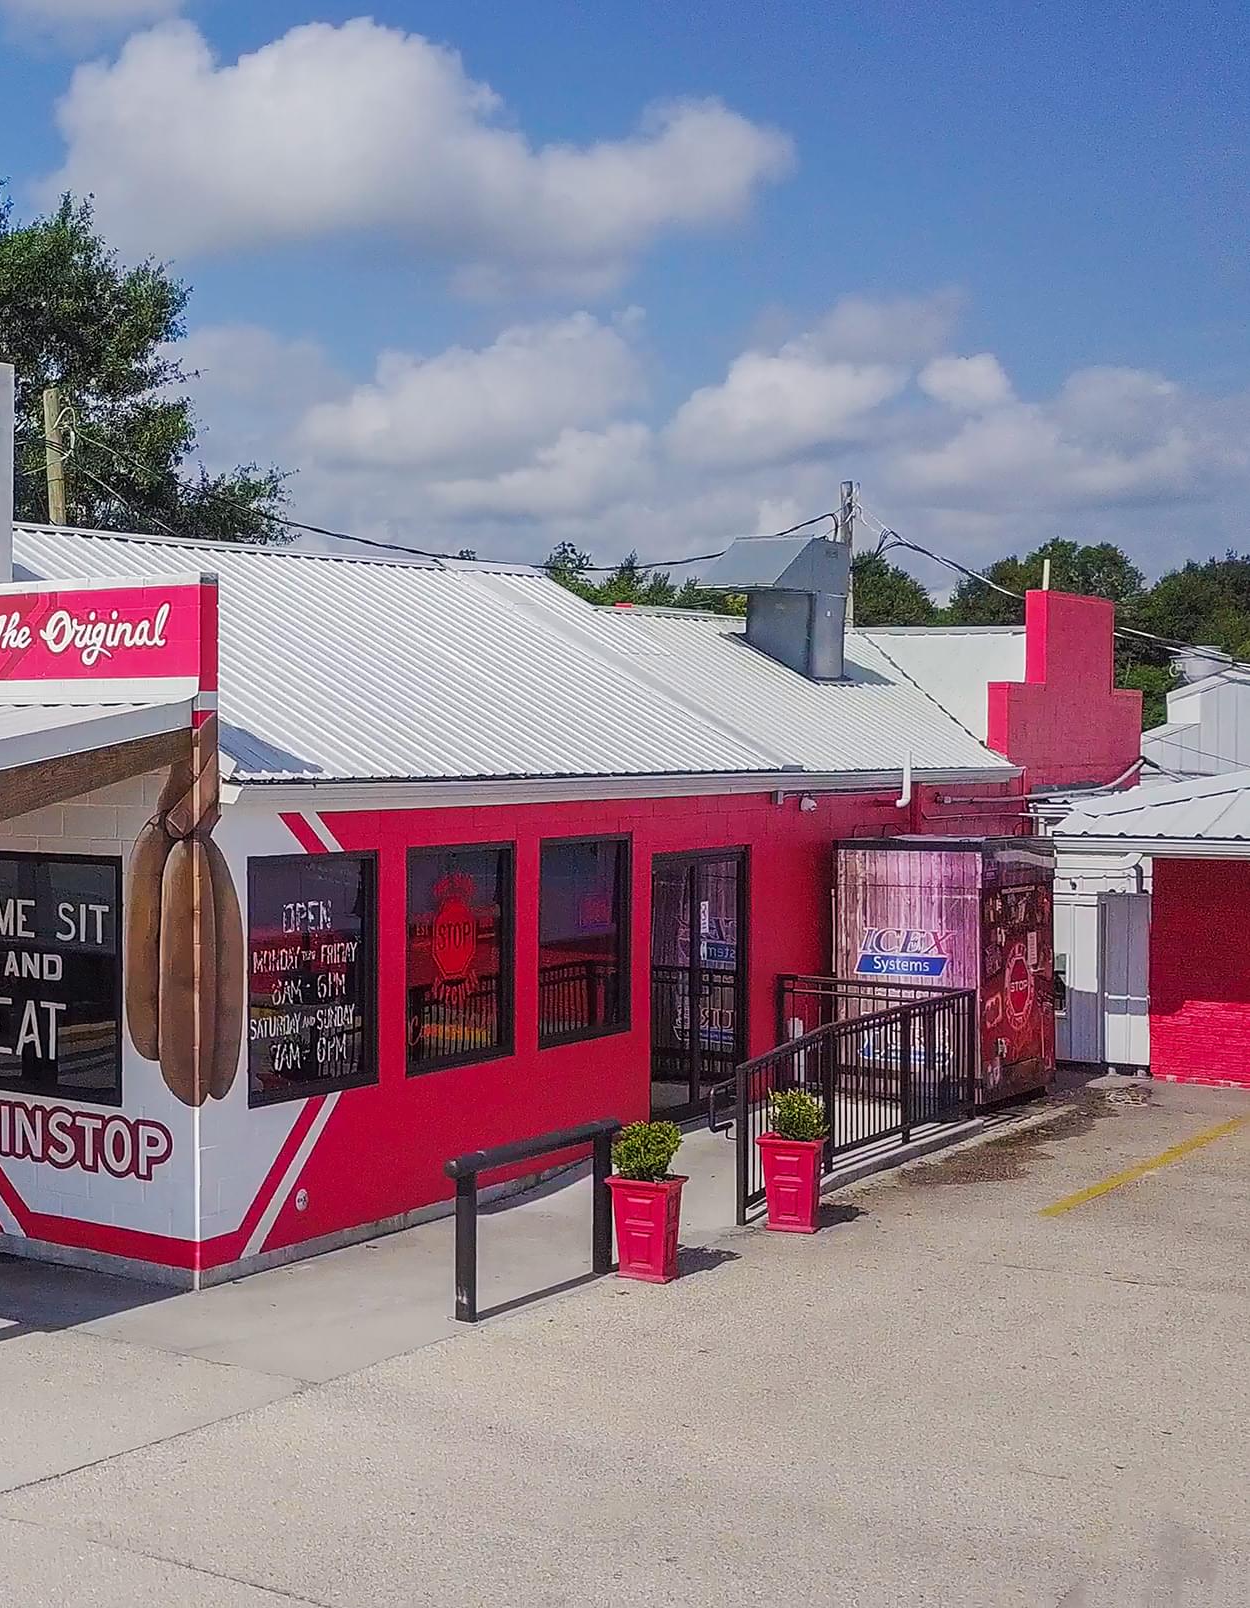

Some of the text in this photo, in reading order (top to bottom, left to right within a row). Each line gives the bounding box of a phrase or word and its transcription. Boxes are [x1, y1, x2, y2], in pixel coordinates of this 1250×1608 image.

[39, 602, 171, 666] Original
[55, 902, 111, 945] SIT
[282, 899, 332, 933] OPEN
[437, 921, 472, 951] STOP
[858, 926, 957, 957] ICEX
[4, 950, 64, 982] AND
[252, 945, 301, 974] MONDAY
[320, 941, 359, 965] FRIDAY
[873, 955, 930, 973] Systems
[249, 1010, 302, 1041] SATURDAY
[316, 1002, 355, 1031] SUNDAY
